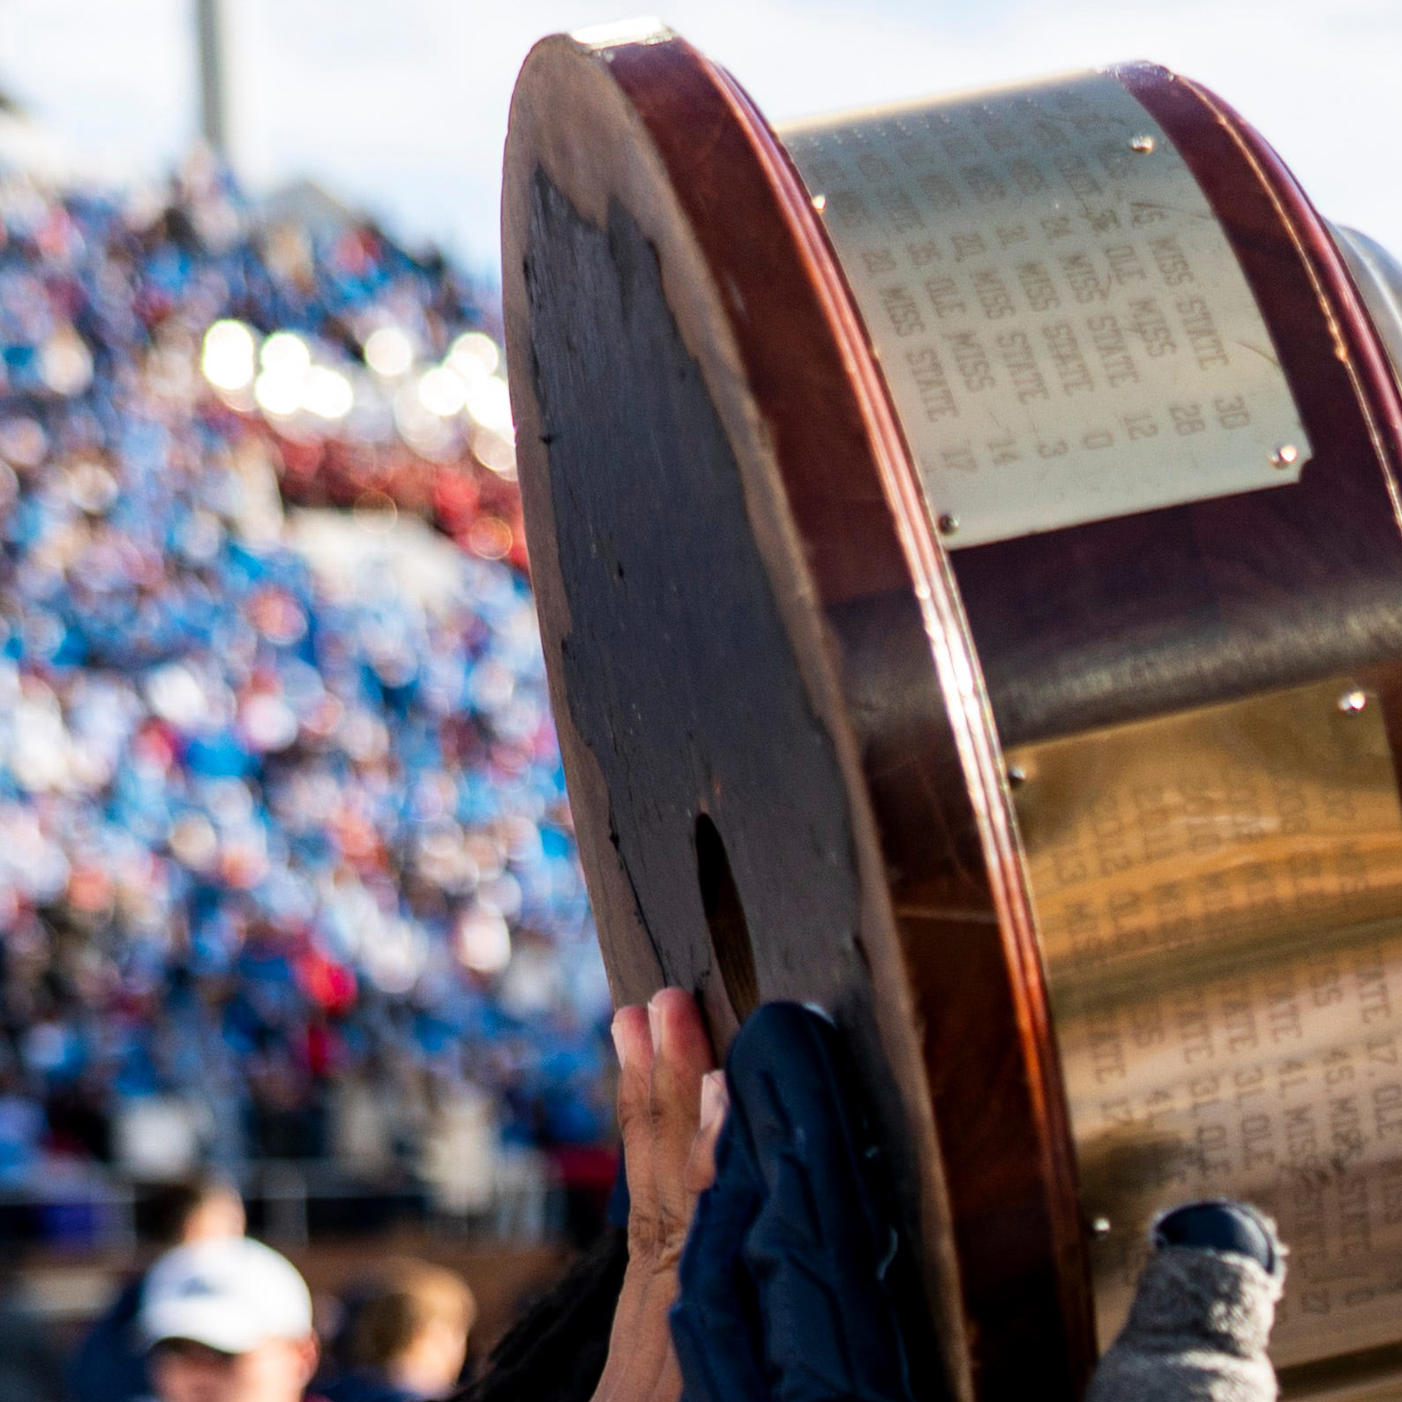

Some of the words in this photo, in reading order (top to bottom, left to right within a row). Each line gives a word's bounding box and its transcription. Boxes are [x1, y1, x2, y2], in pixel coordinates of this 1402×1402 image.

[943, 329, 998, 391] MISS
[967, 267, 1017, 318] MISS
[992, 333, 1052, 404] STATE
[1125, 297, 1178, 357] MISS
[1146, 237, 1194, 285] MISS
[1173, 299, 1230, 367] STATE
[1212, 396, 1253, 428] 30
[900, 347, 962, 421] STATE
[1037, 324, 1097, 396] STATE
[1080, 431, 1116, 451] 0
[1081, 314, 1141, 387] STATE
[1120, 412, 1161, 441] 12
[1234, 1113, 1277, 1172] OLE
